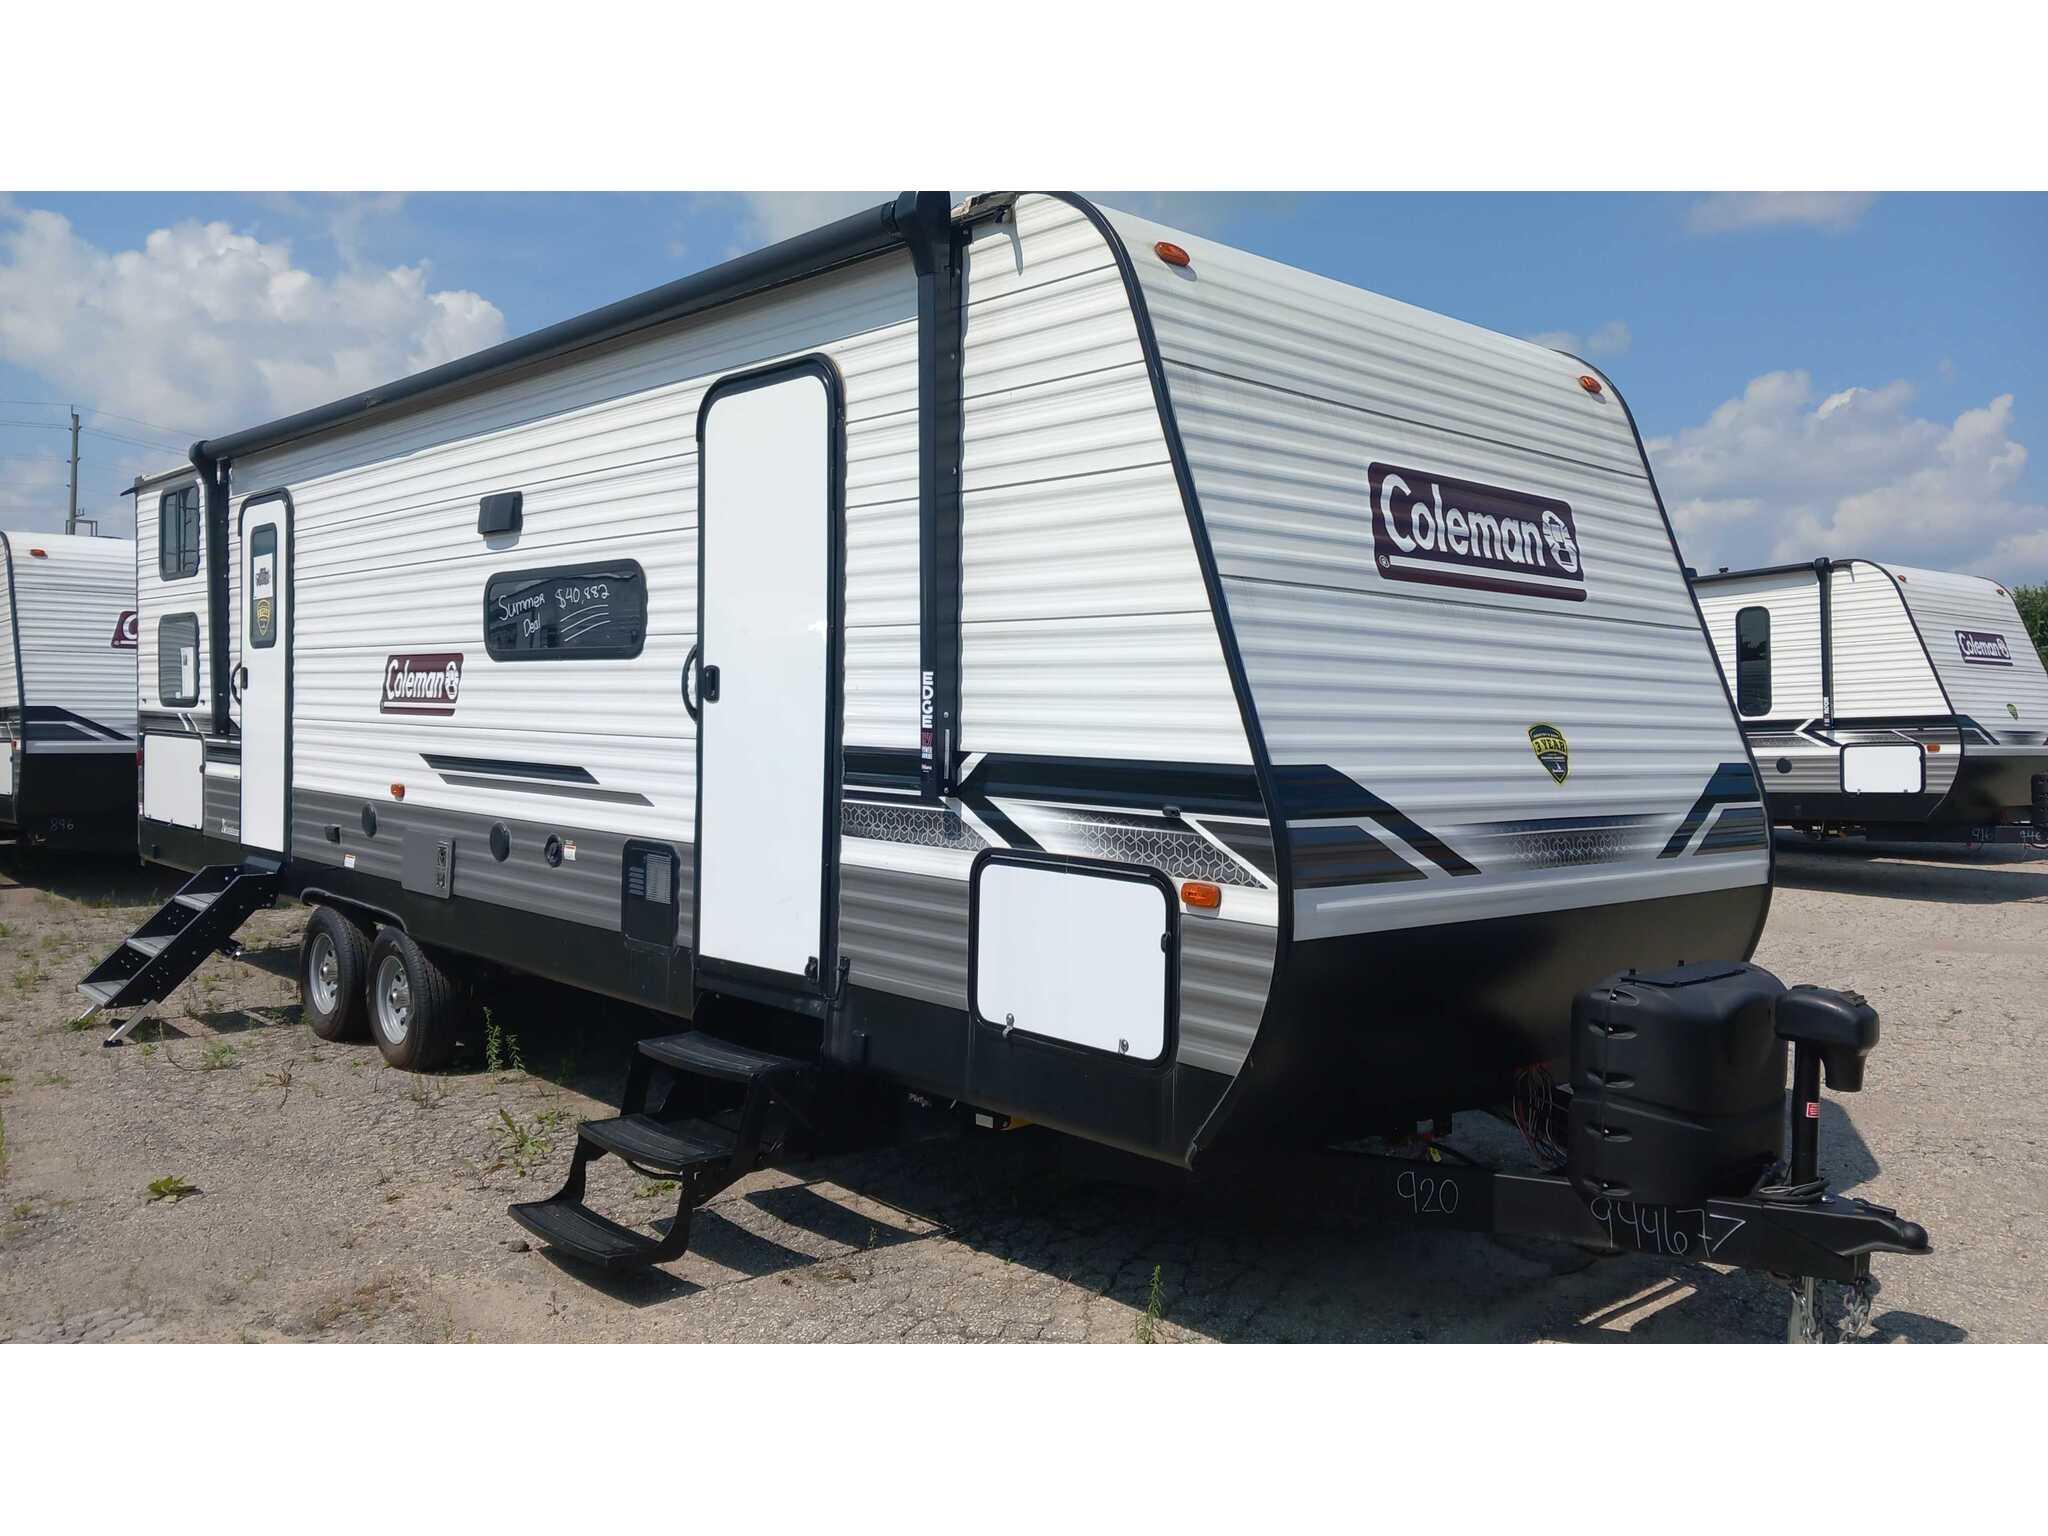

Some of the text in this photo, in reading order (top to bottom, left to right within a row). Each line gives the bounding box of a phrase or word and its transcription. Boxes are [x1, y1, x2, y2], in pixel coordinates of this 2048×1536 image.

[1380, 474, 1546, 566] Coleman
[555, 584, 610, 608] $40,882
[523, 613, 541, 637] Deal
[1958, 633, 2001, 656] Coleman
[386, 659, 445, 700] Coleman
[922, 671, 934, 729] EDGE
[1534, 738, 1566, 752] 3 YEAR
[1397, 1171, 1459, 1214] 920
